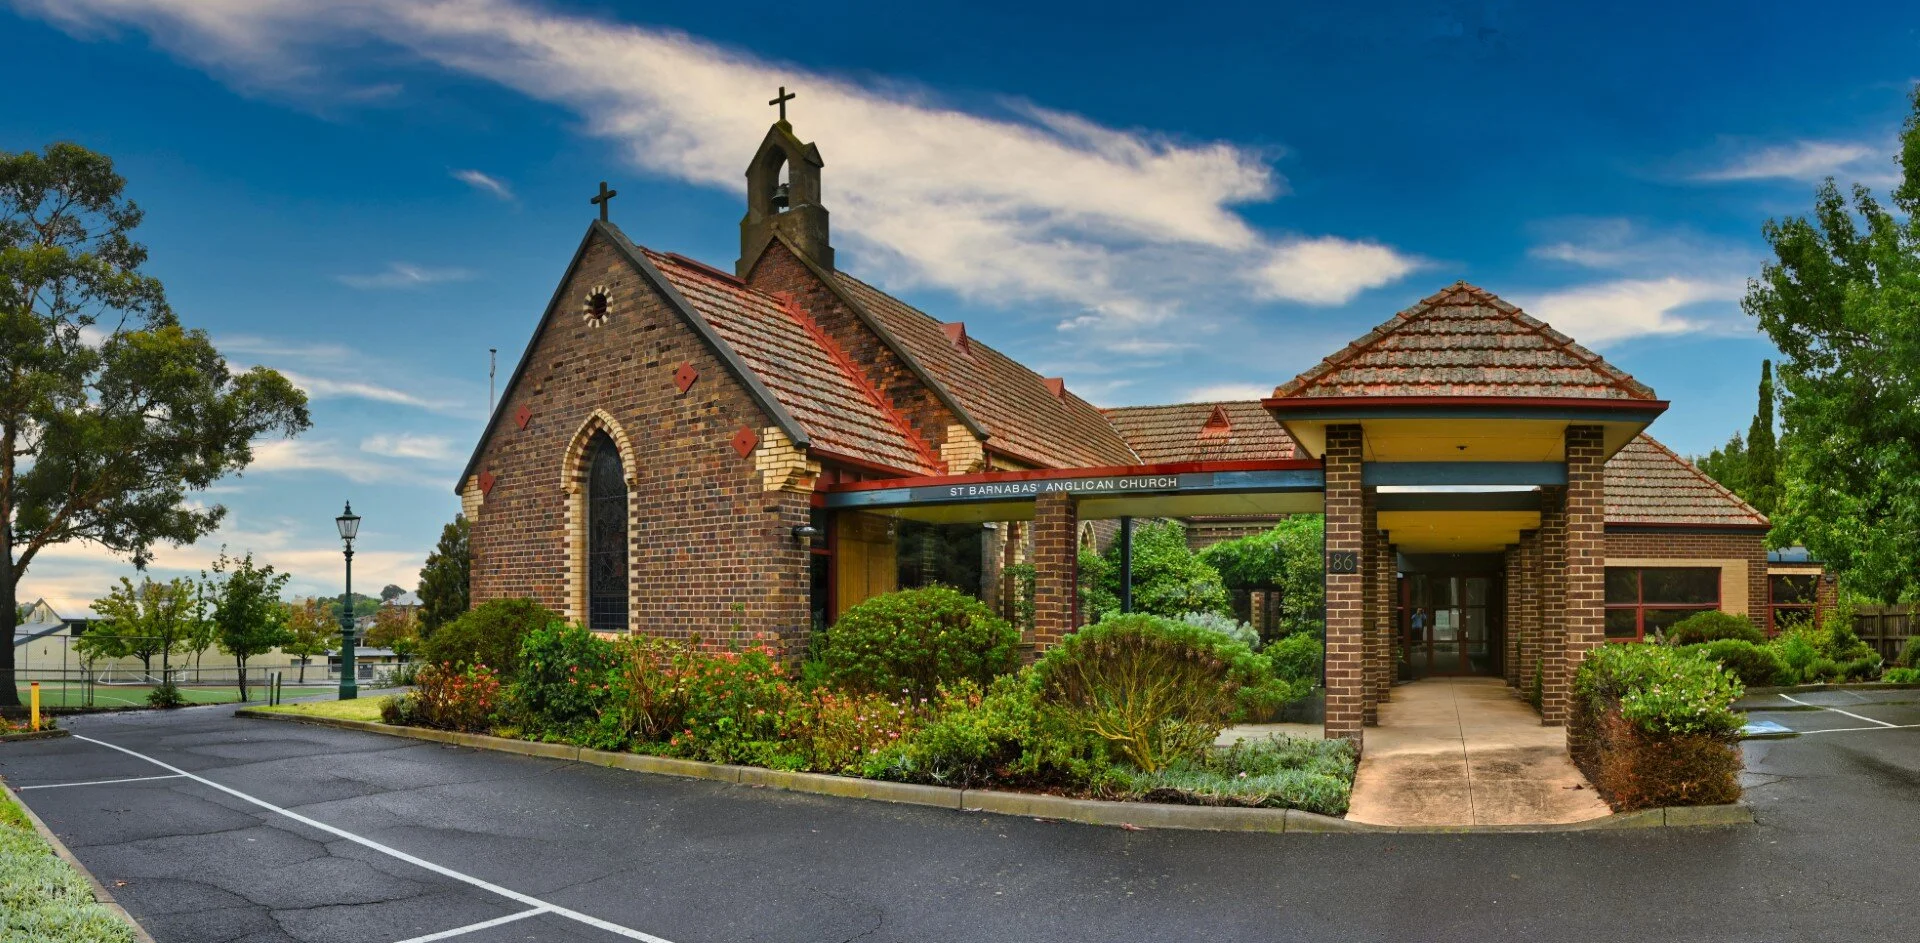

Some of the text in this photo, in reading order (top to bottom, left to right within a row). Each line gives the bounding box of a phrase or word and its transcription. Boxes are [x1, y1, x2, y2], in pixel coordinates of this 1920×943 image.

[950, 477, 1177, 496] ST BARNABAS' ANGLICAN CHURCH
[1333, 553, 1353, 571] 86
